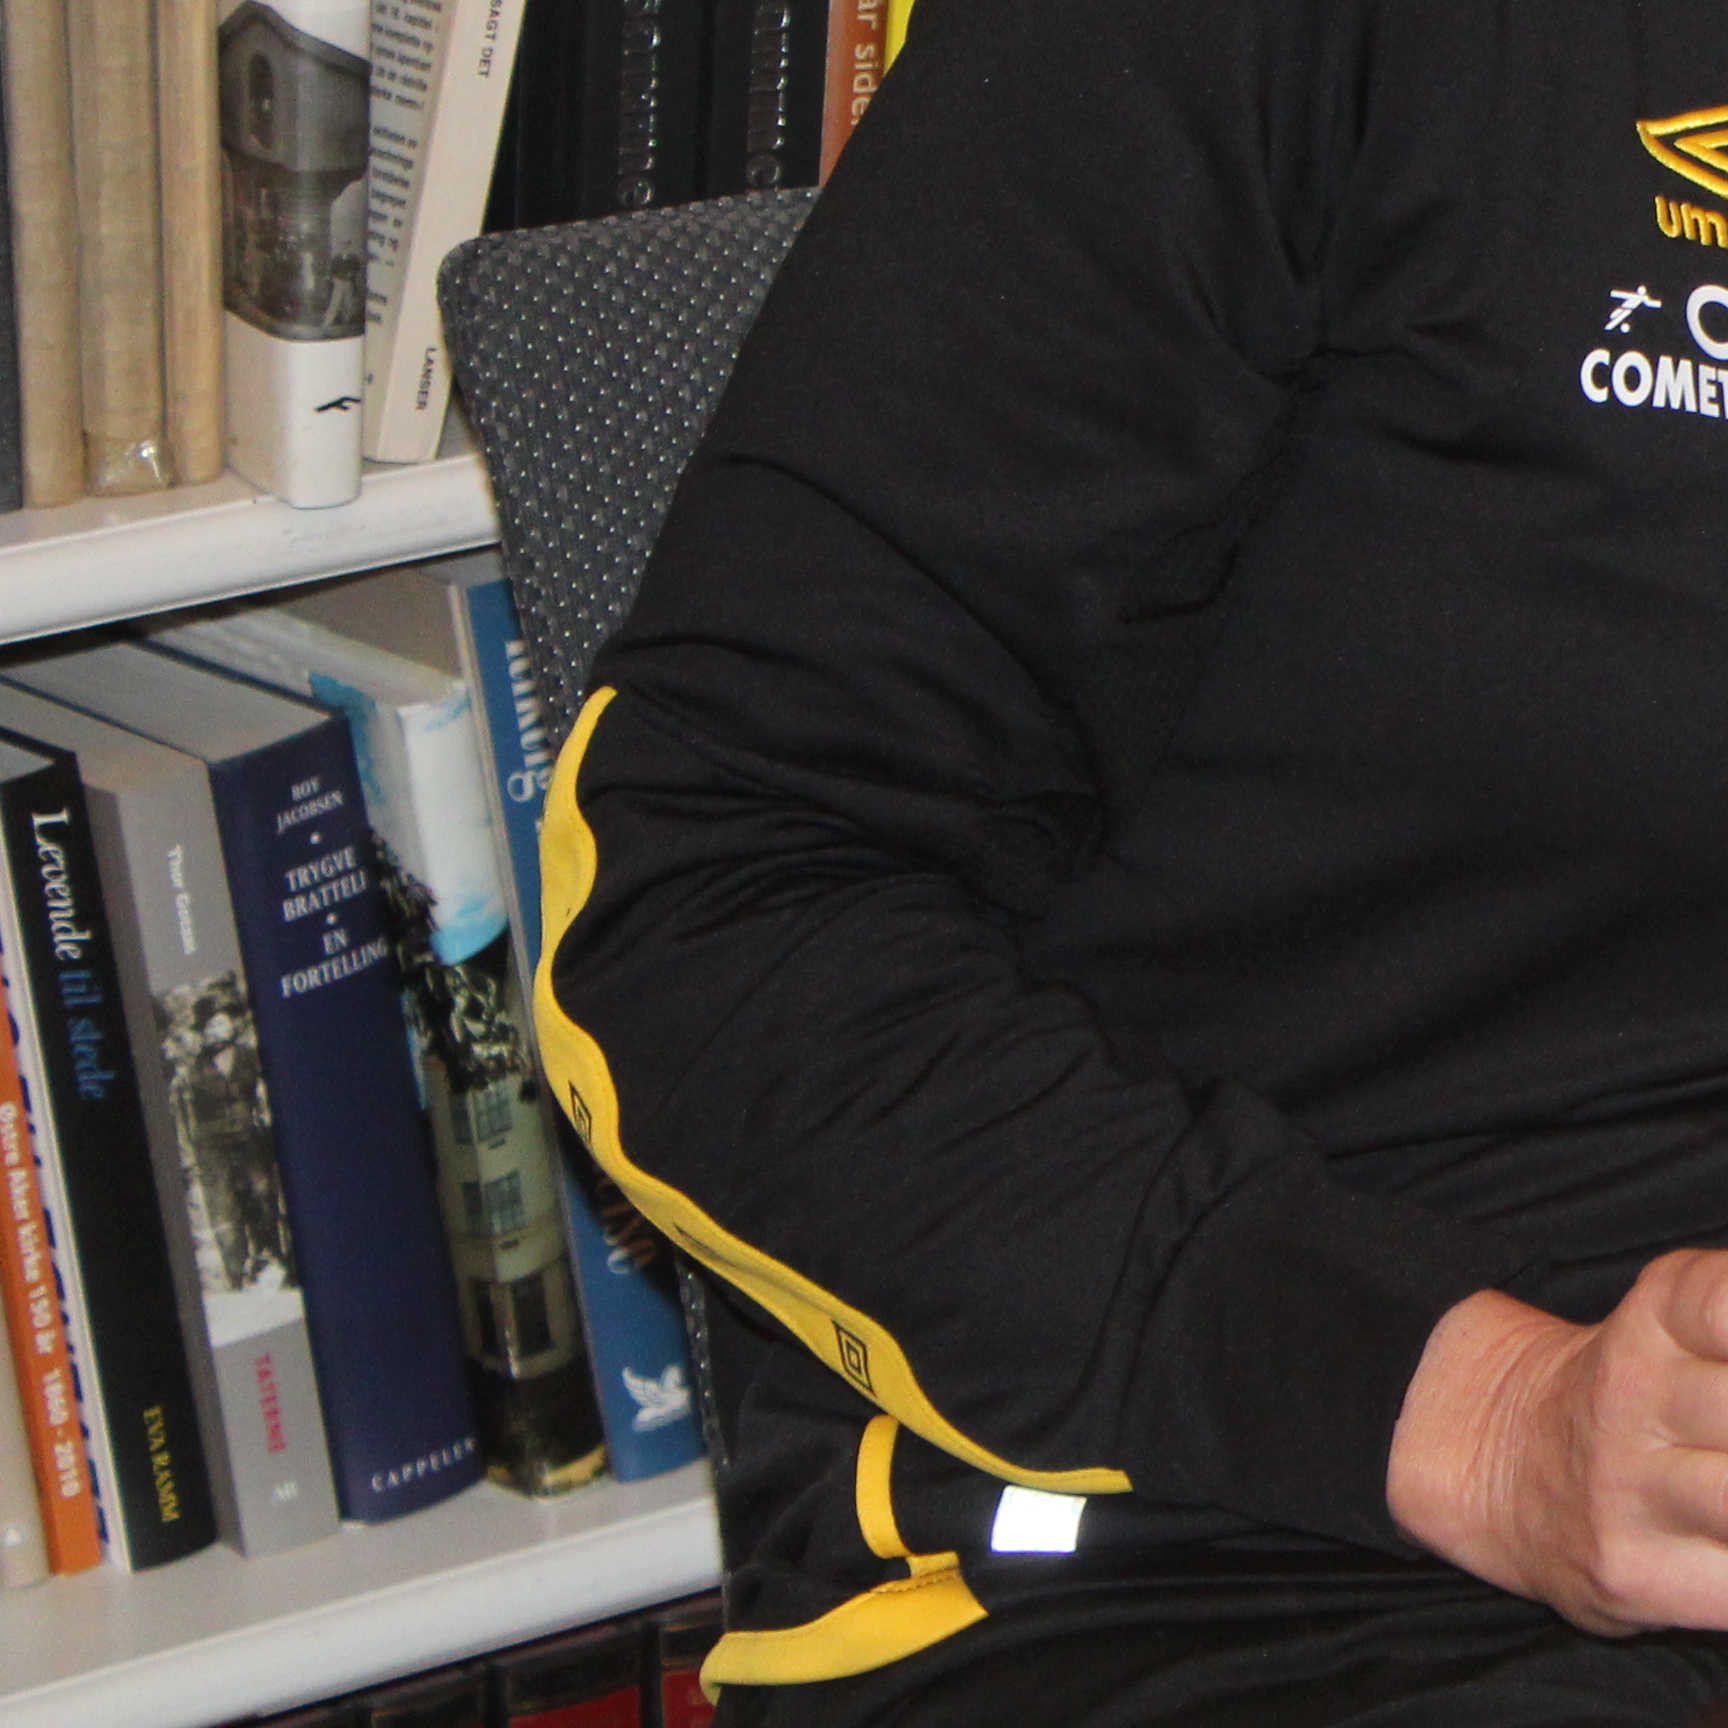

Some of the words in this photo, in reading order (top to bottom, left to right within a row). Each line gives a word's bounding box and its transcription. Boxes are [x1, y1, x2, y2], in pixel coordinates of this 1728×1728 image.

[475, 45, 492, 79] DET
[413, 346, 439, 412] LANSER
[276, 790, 344, 834] JACOBSEN
[32, 808, 94, 961] Levende
[285, 845, 356, 892] TRYGVE
[282, 871, 368, 922] BRATTELI
[322, 927, 349, 955] EN
[59, 969, 103, 1007] til
[279, 937, 390, 998] FORTELLING
[8, 1168, 30, 1221] Aker
[16, 1221, 42, 1284] kirke
[34, 1324, 53, 1355] år
[143, 1405, 167, 1453] EVA
[53, 1439, 82, 1499] 2010
[150, 1453, 183, 1523] RAMM
